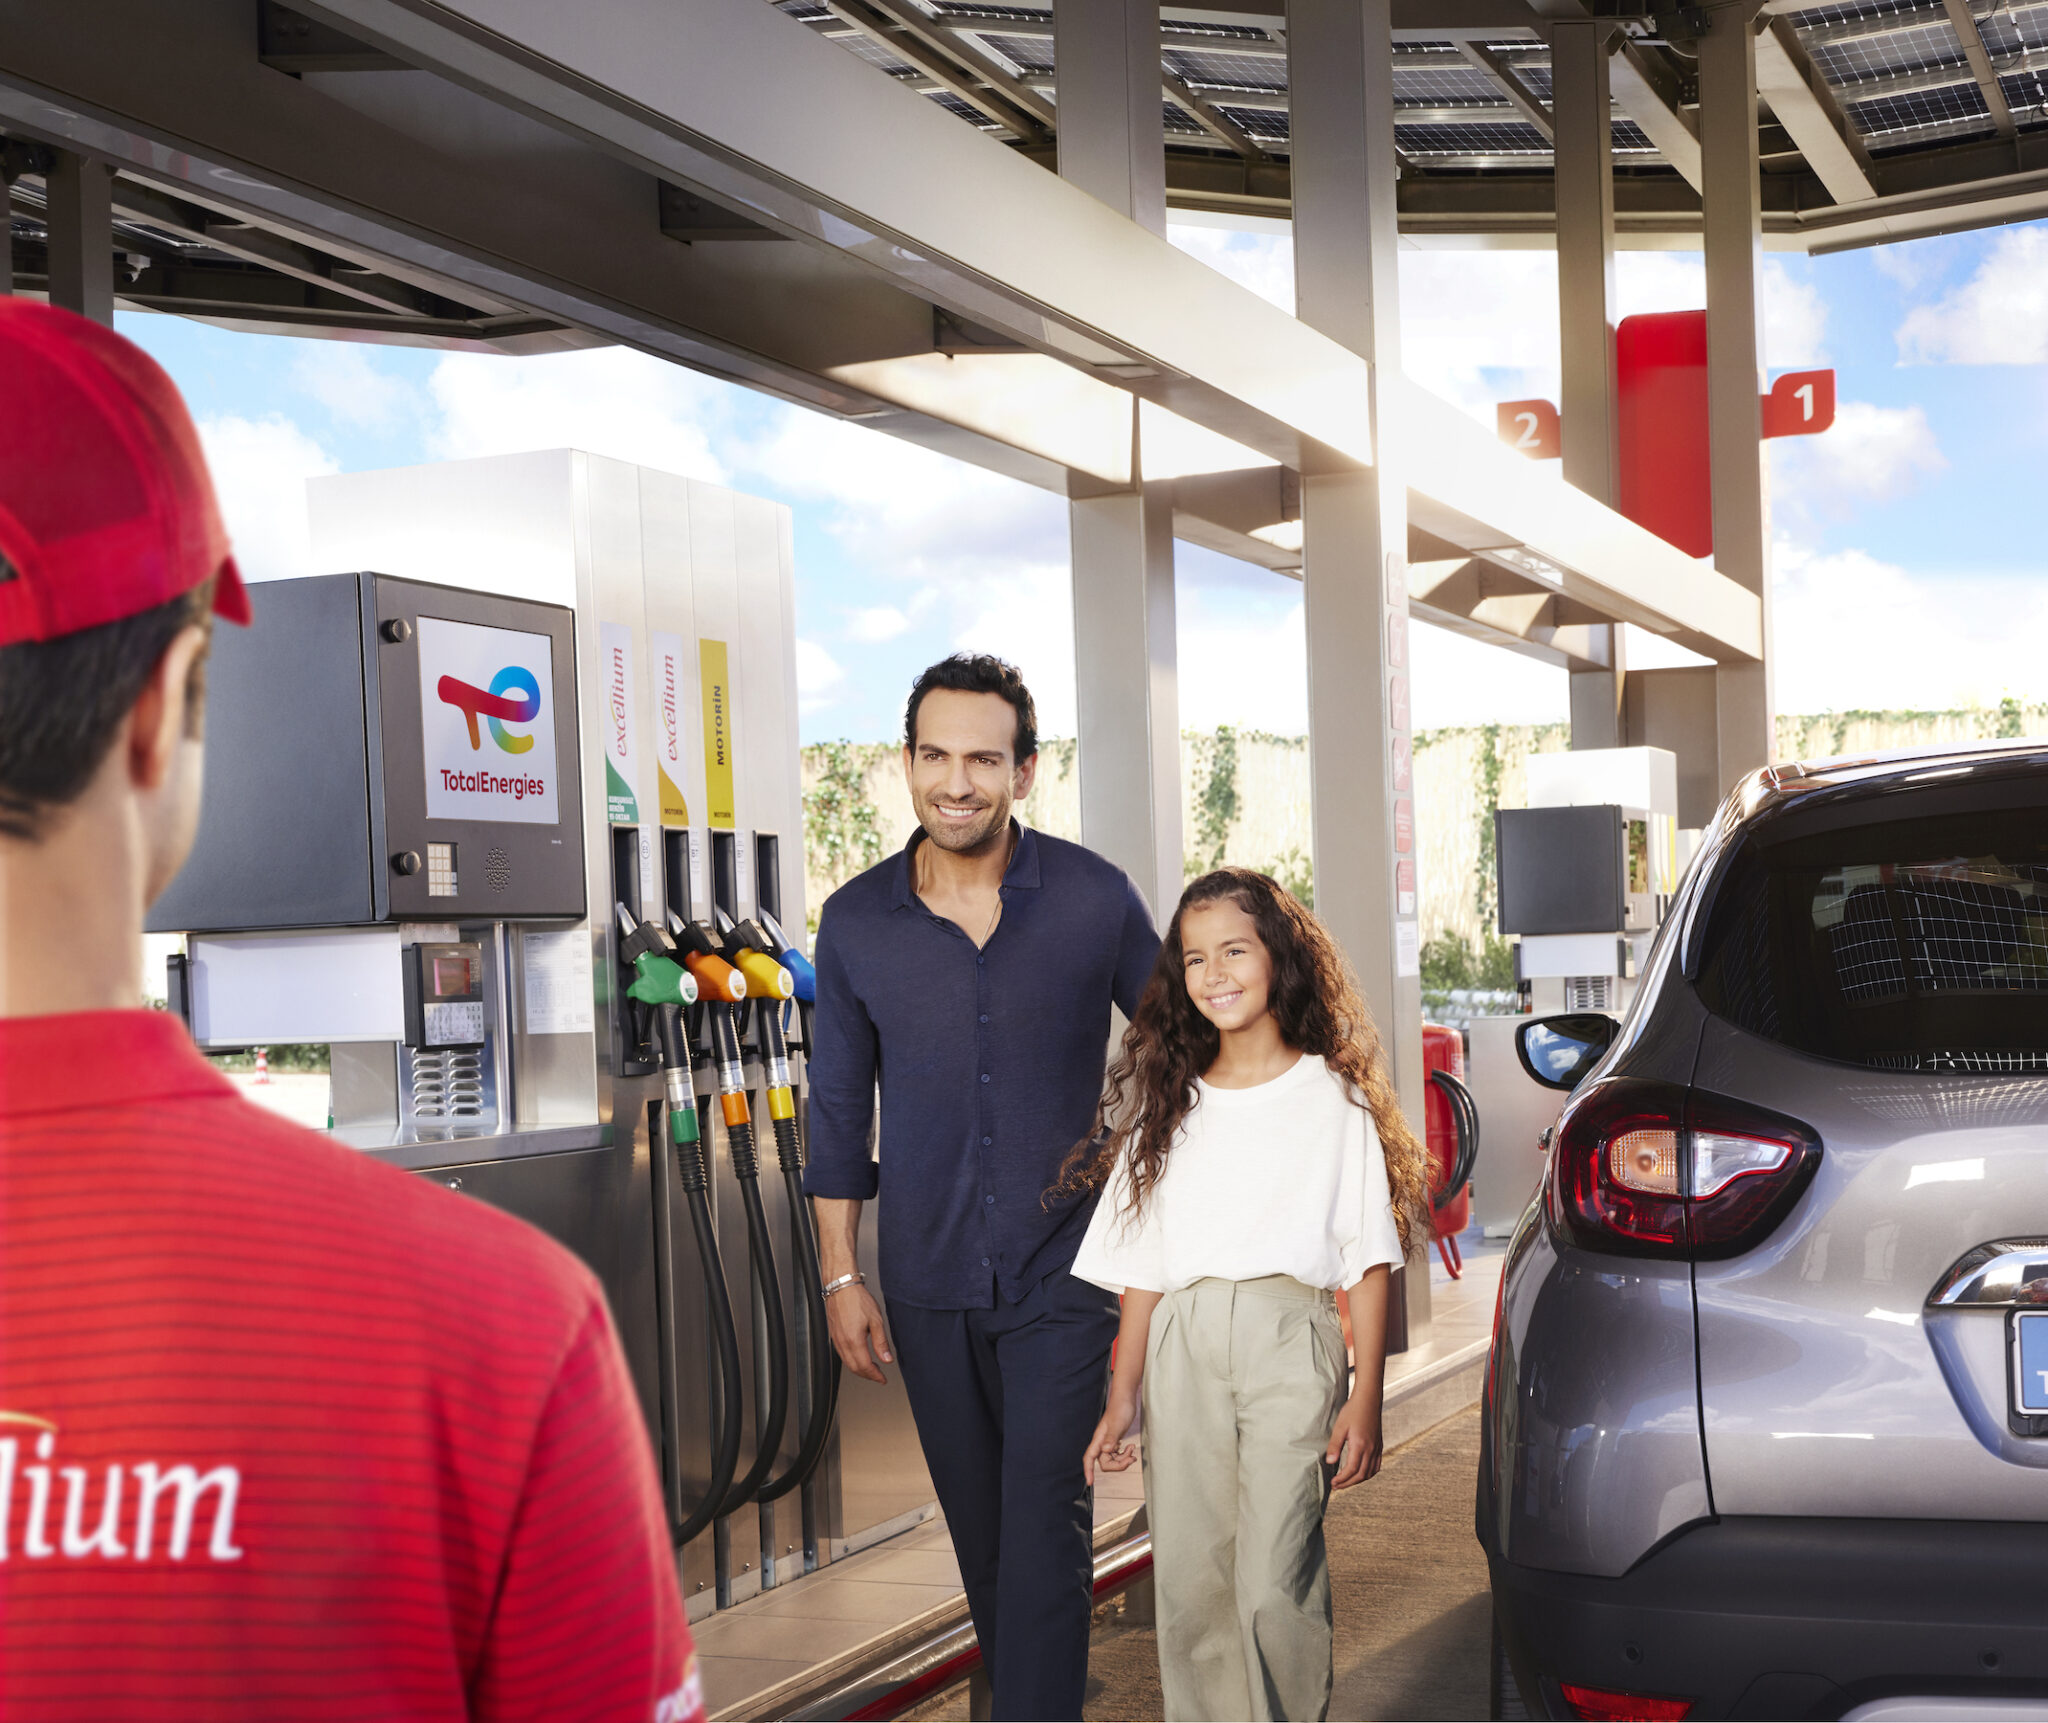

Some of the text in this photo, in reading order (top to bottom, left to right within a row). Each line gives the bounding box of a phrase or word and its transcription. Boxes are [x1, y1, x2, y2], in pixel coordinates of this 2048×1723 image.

[1793, 384, 1814, 421] 1
[1514, 412, 1542, 449] 2
[611, 647, 627, 757] excellium
[663, 654, 678, 761] excellium
[440, 769, 544, 800] TotalEnergies
